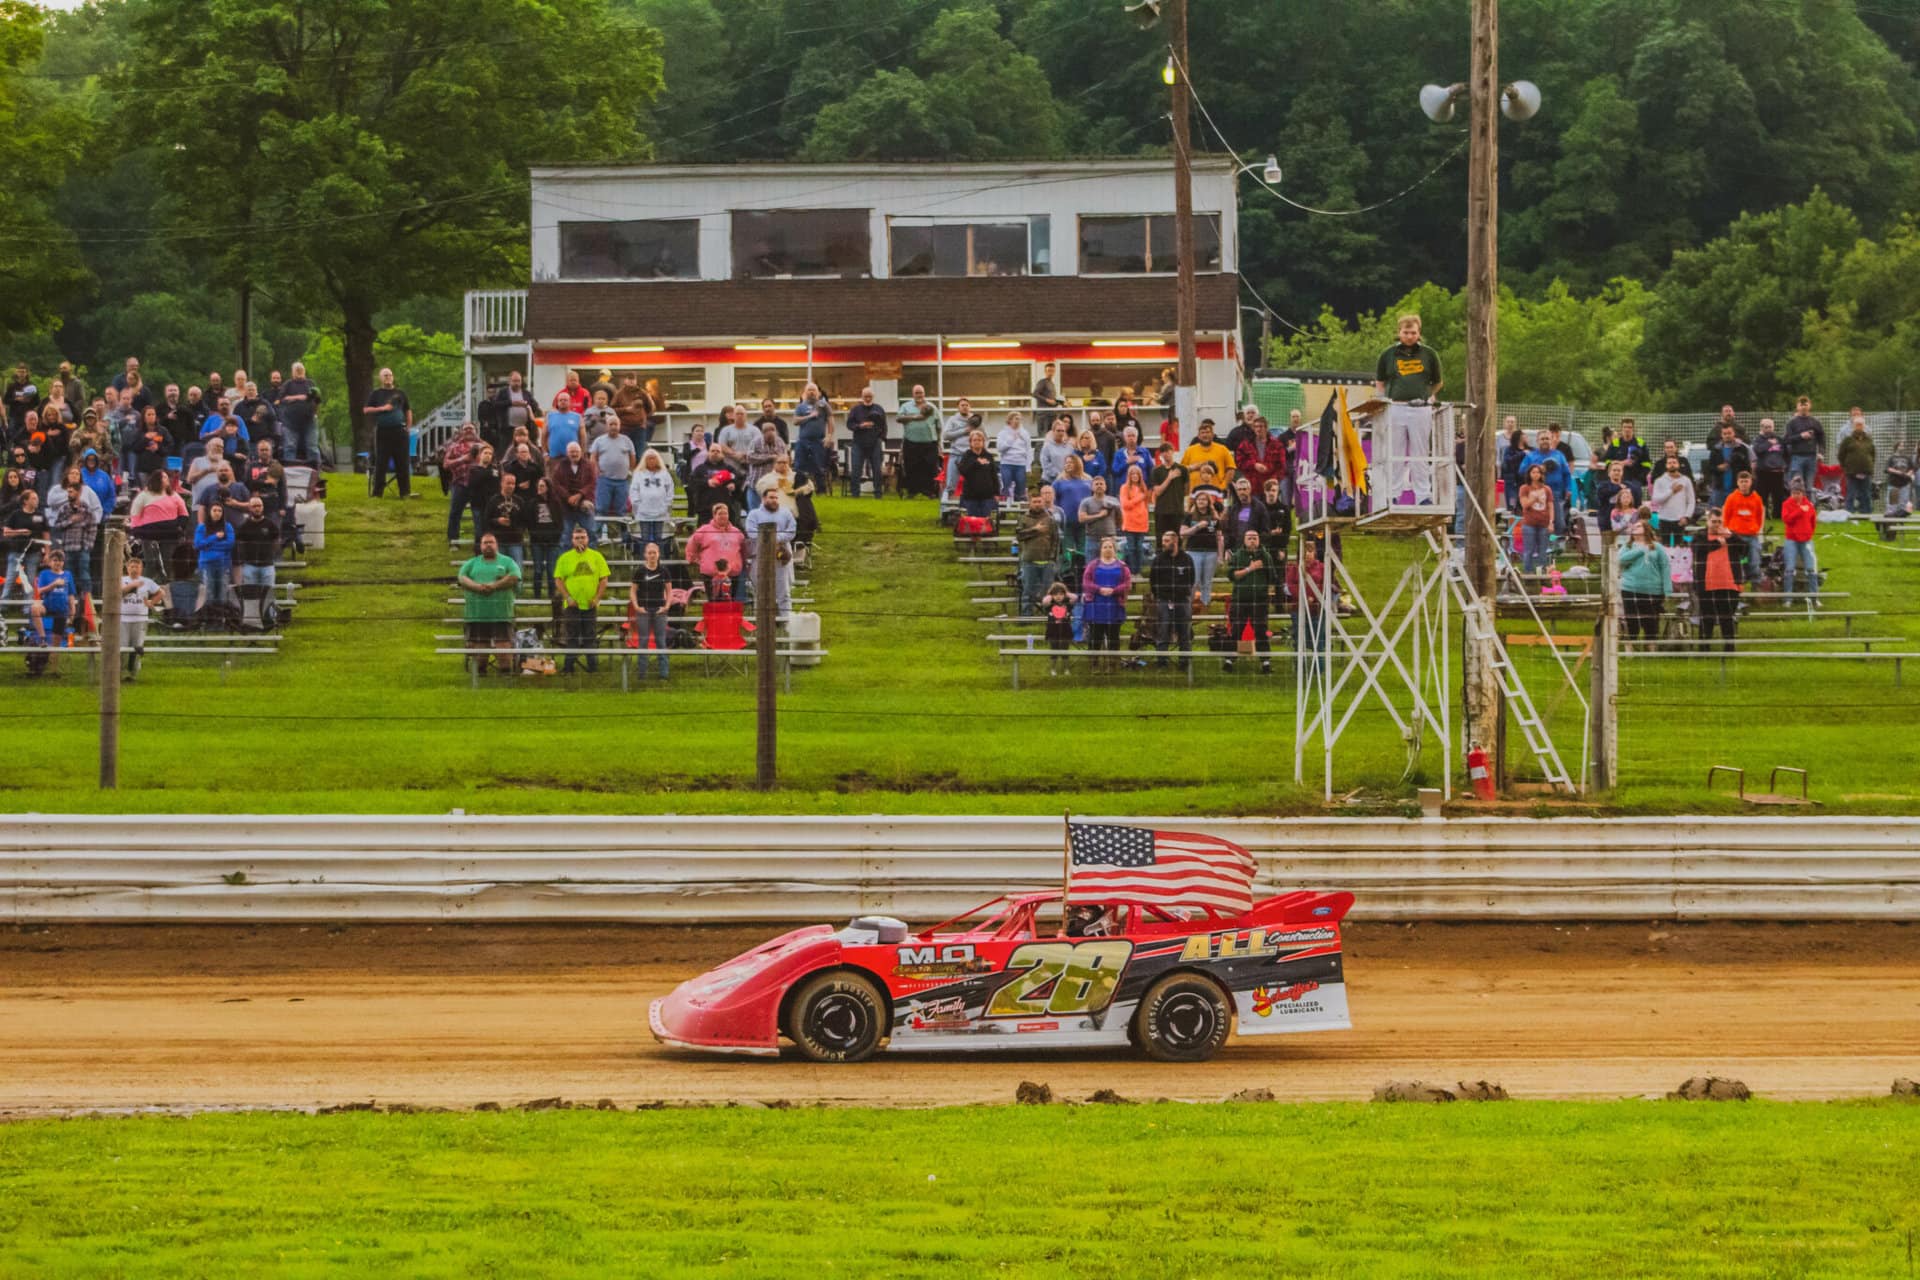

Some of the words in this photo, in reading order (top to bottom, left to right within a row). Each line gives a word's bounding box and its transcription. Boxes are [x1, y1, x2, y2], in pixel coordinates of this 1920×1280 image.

[1269, 929, 1336, 944] Construction
[983, 939, 1134, 1018] 28
[921, 995, 966, 1020] Family
[1275, 1001, 1319, 1009] SPECIALIZED
[1280, 1006, 1324, 1015] LUBRICANTS
